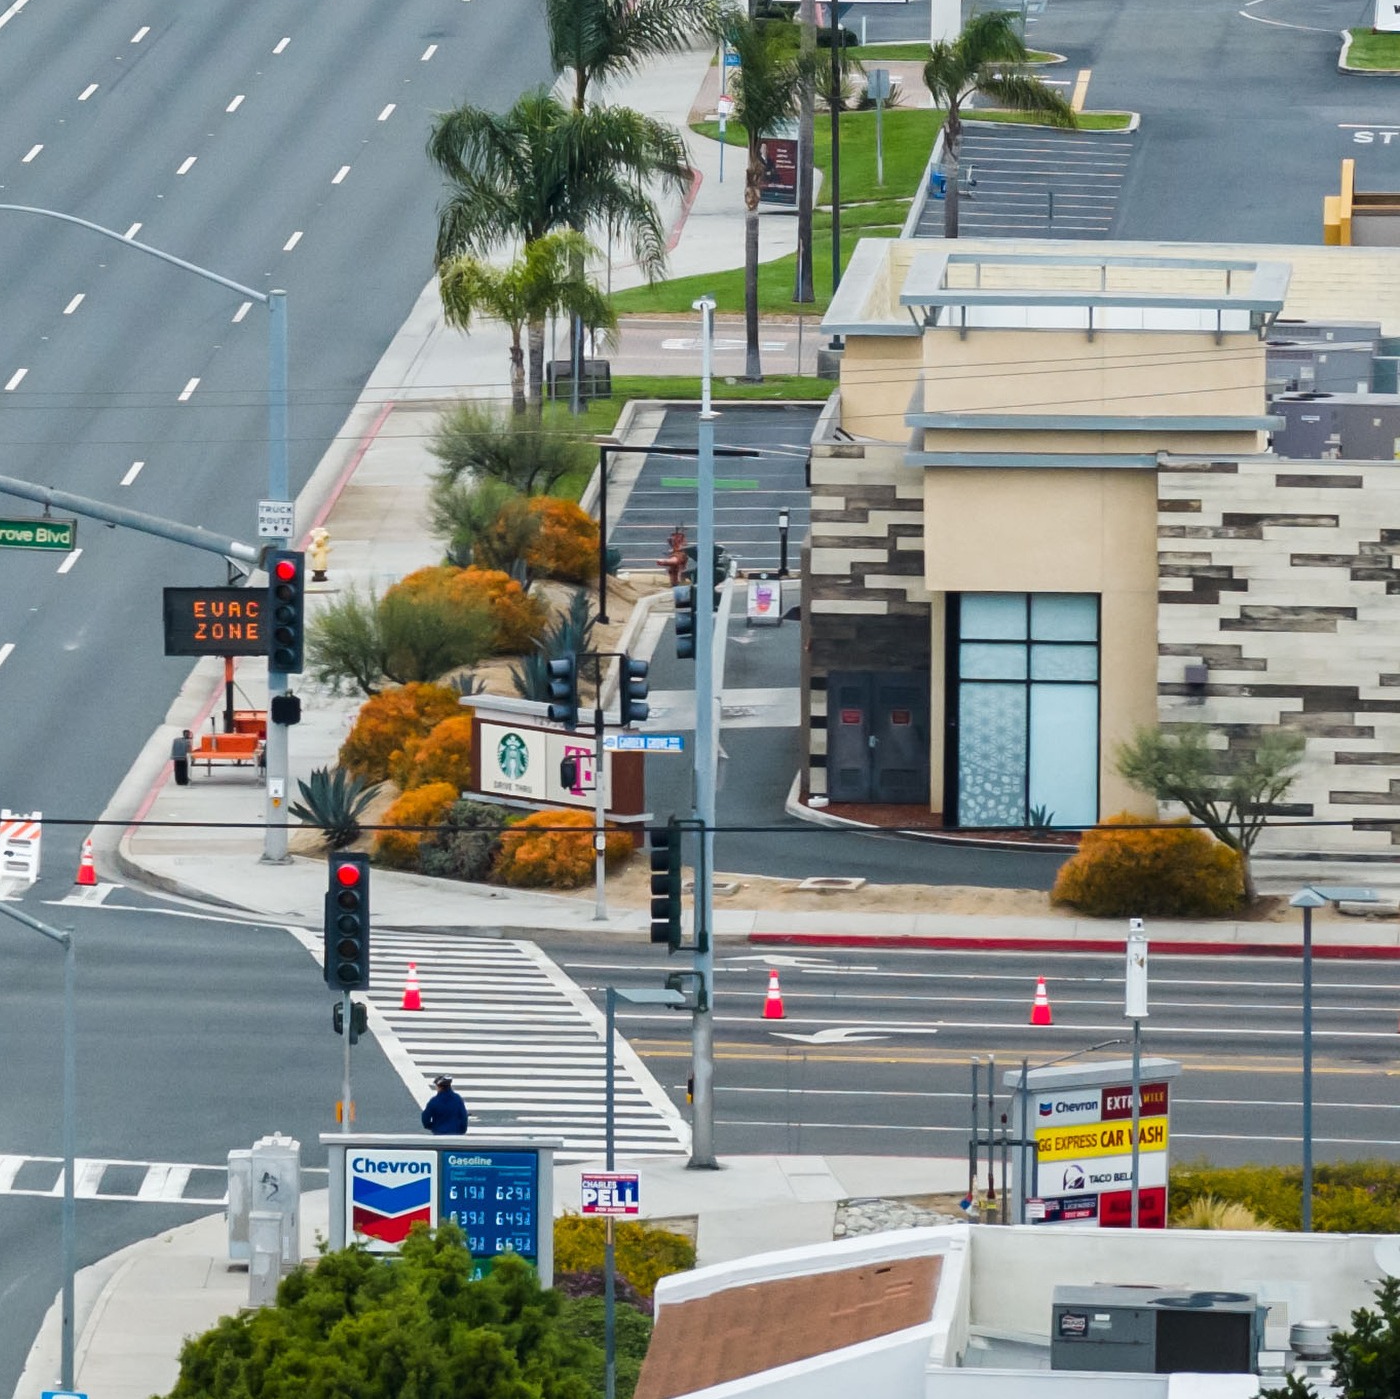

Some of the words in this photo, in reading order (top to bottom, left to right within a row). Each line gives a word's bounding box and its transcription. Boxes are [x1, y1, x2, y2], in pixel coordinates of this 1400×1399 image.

[260, 505, 292, 514] TRUCK
[259, 516, 292, 525] ROUTE
[36, 528, 71, 544] Blvd
[193, 601, 260, 618] EVAC
[194, 623, 260, 640] ZONE
[494, 780, 513, 792] DRIVE
[515, 784, 533, 794] THRU
[1055, 1100, 1098, 1114] Chevron
[1055, 1133, 1097, 1151] EXPRESS
[1100, 1129, 1124, 1148] CAR
[352, 1157, 431, 1175] Chevron
[448, 1155, 492, 1166] Gasoline
[1089, 1173, 1112, 1183] TACO
